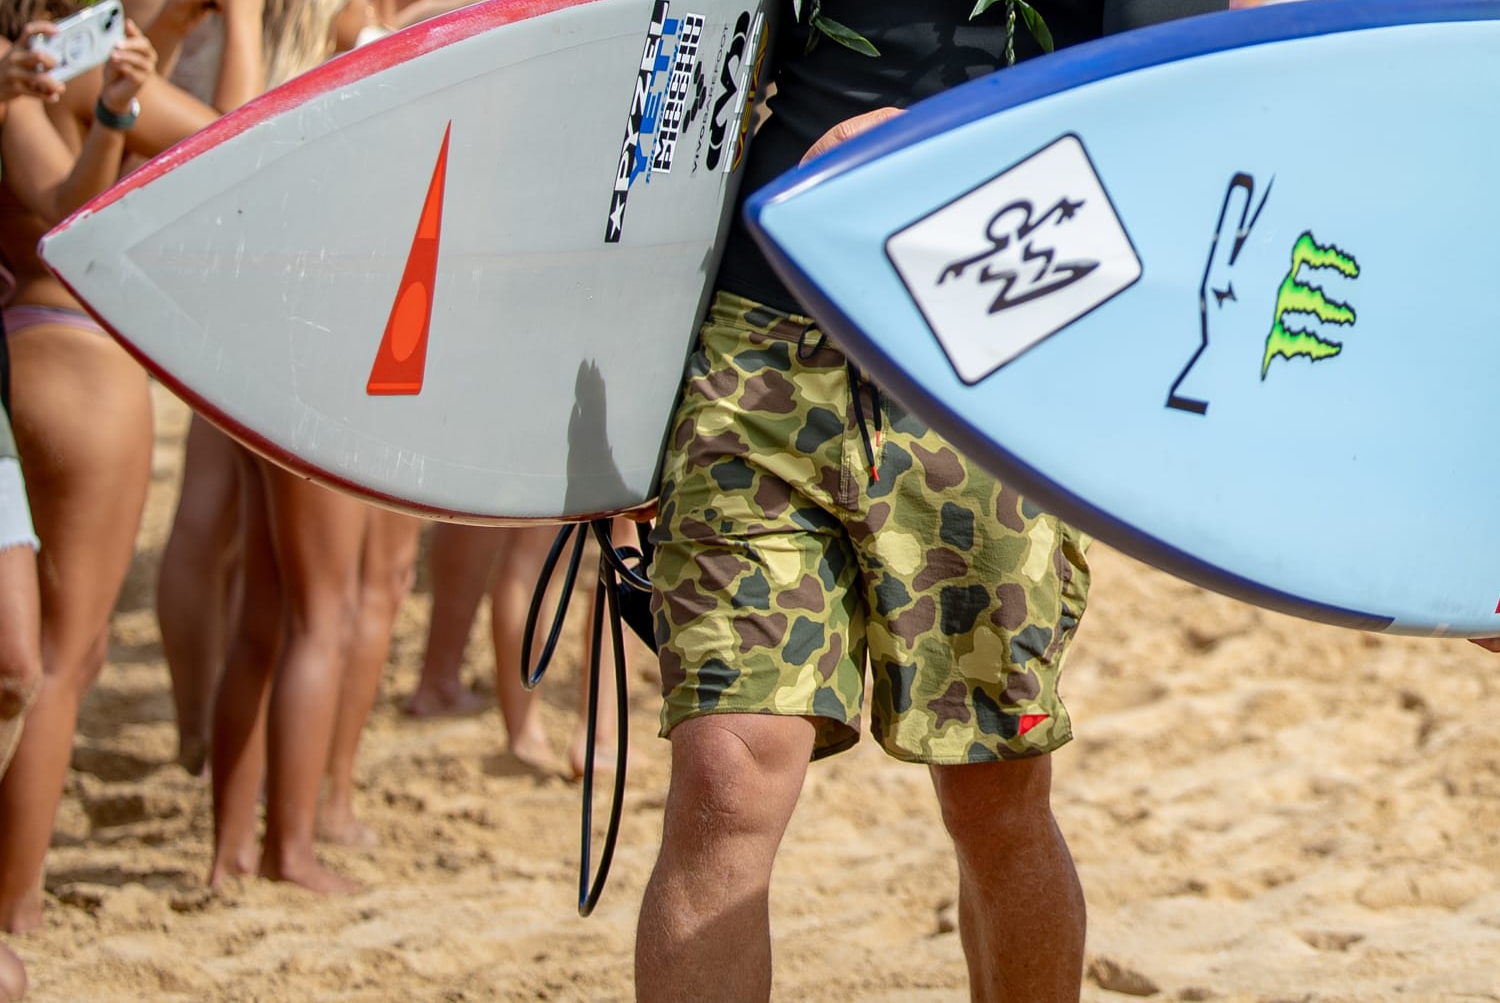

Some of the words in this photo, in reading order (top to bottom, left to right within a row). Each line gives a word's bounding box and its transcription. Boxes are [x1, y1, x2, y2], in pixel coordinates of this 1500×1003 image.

[614, 1, 669, 191] PYZEL
[629, 18, 679, 187] YETI
[653, 16, 694, 169] MACHU
[661, 18, 703, 171] PICCHU
